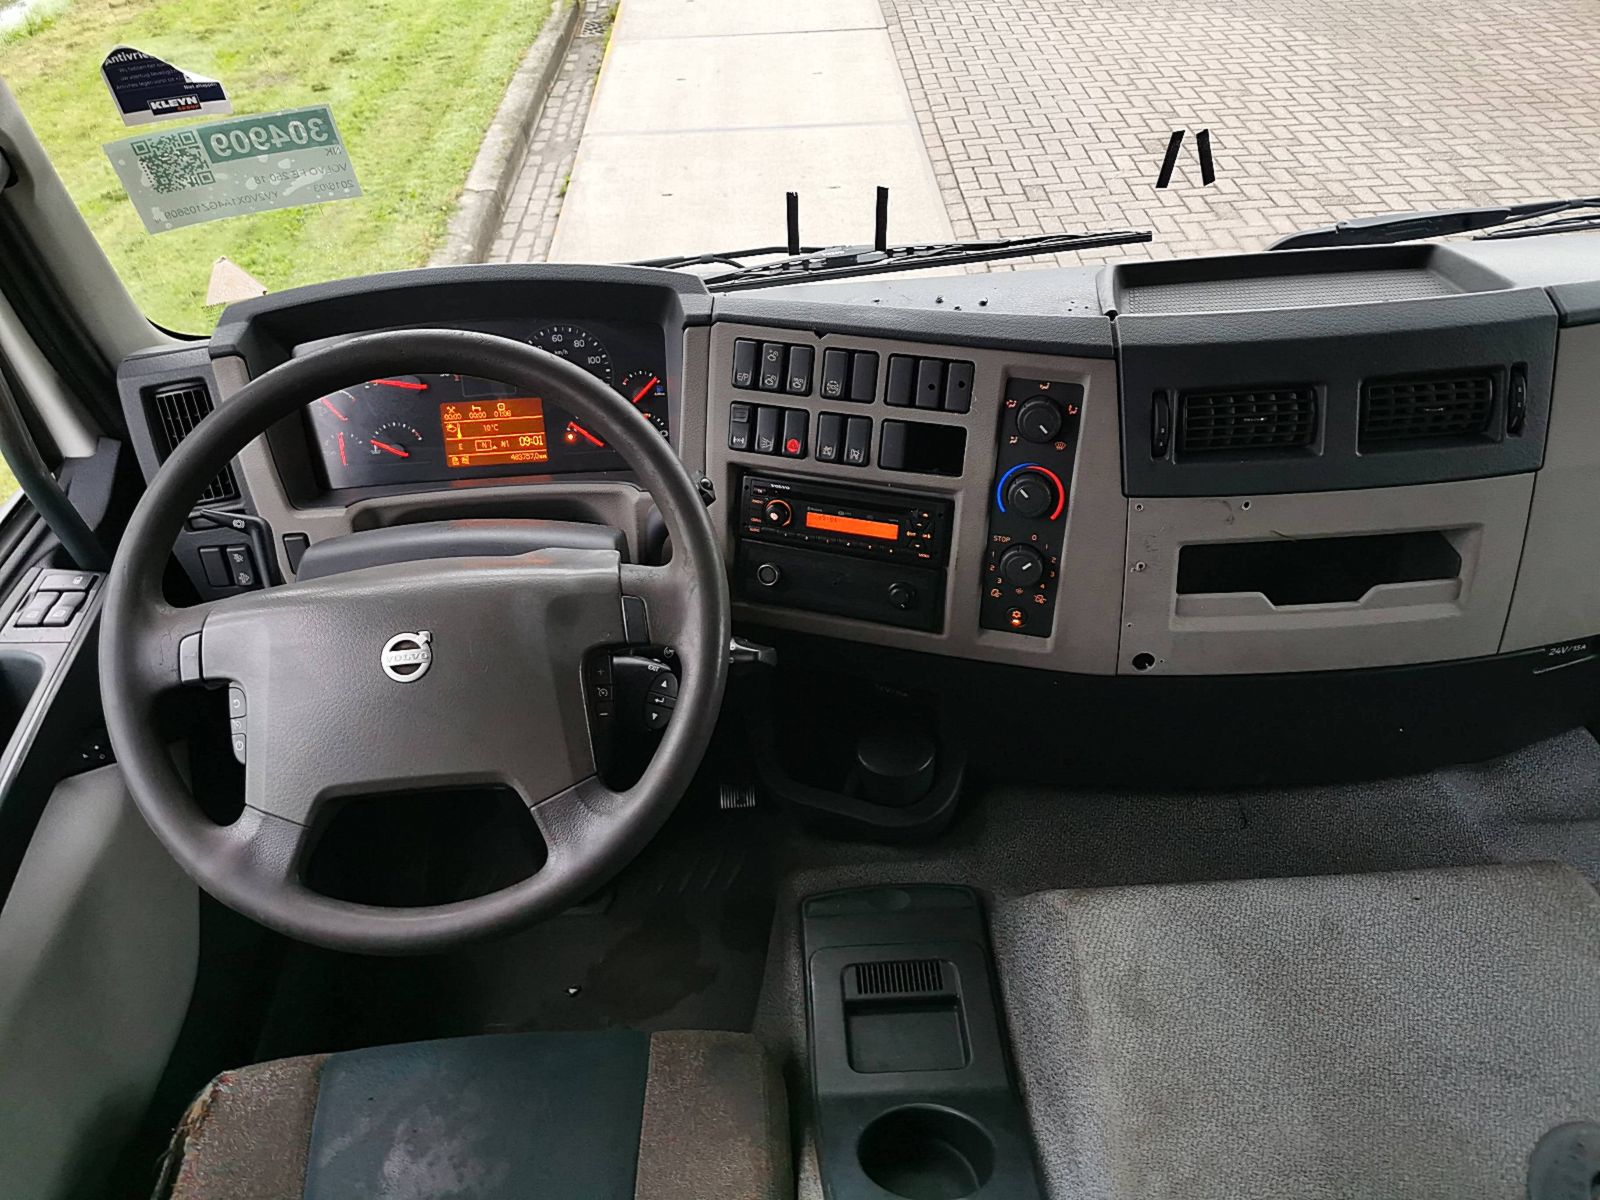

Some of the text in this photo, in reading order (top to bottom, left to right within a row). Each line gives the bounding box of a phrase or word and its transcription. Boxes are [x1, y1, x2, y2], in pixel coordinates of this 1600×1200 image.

[105, 50, 155, 66] Antivrie
[150, 96, 198, 110] KLEYN
[551, 334, 563, 343] 60
[573, 339, 585, 348] 80
[588, 355, 601, 364] 100
[469, 411, 487, 419] 00:00
[519, 435, 544, 447] 09:01
[993, 535, 1011, 543] STOP
[1051, 556, 1057, 564] 2
[387, 652, 429, 663] VOLVO
